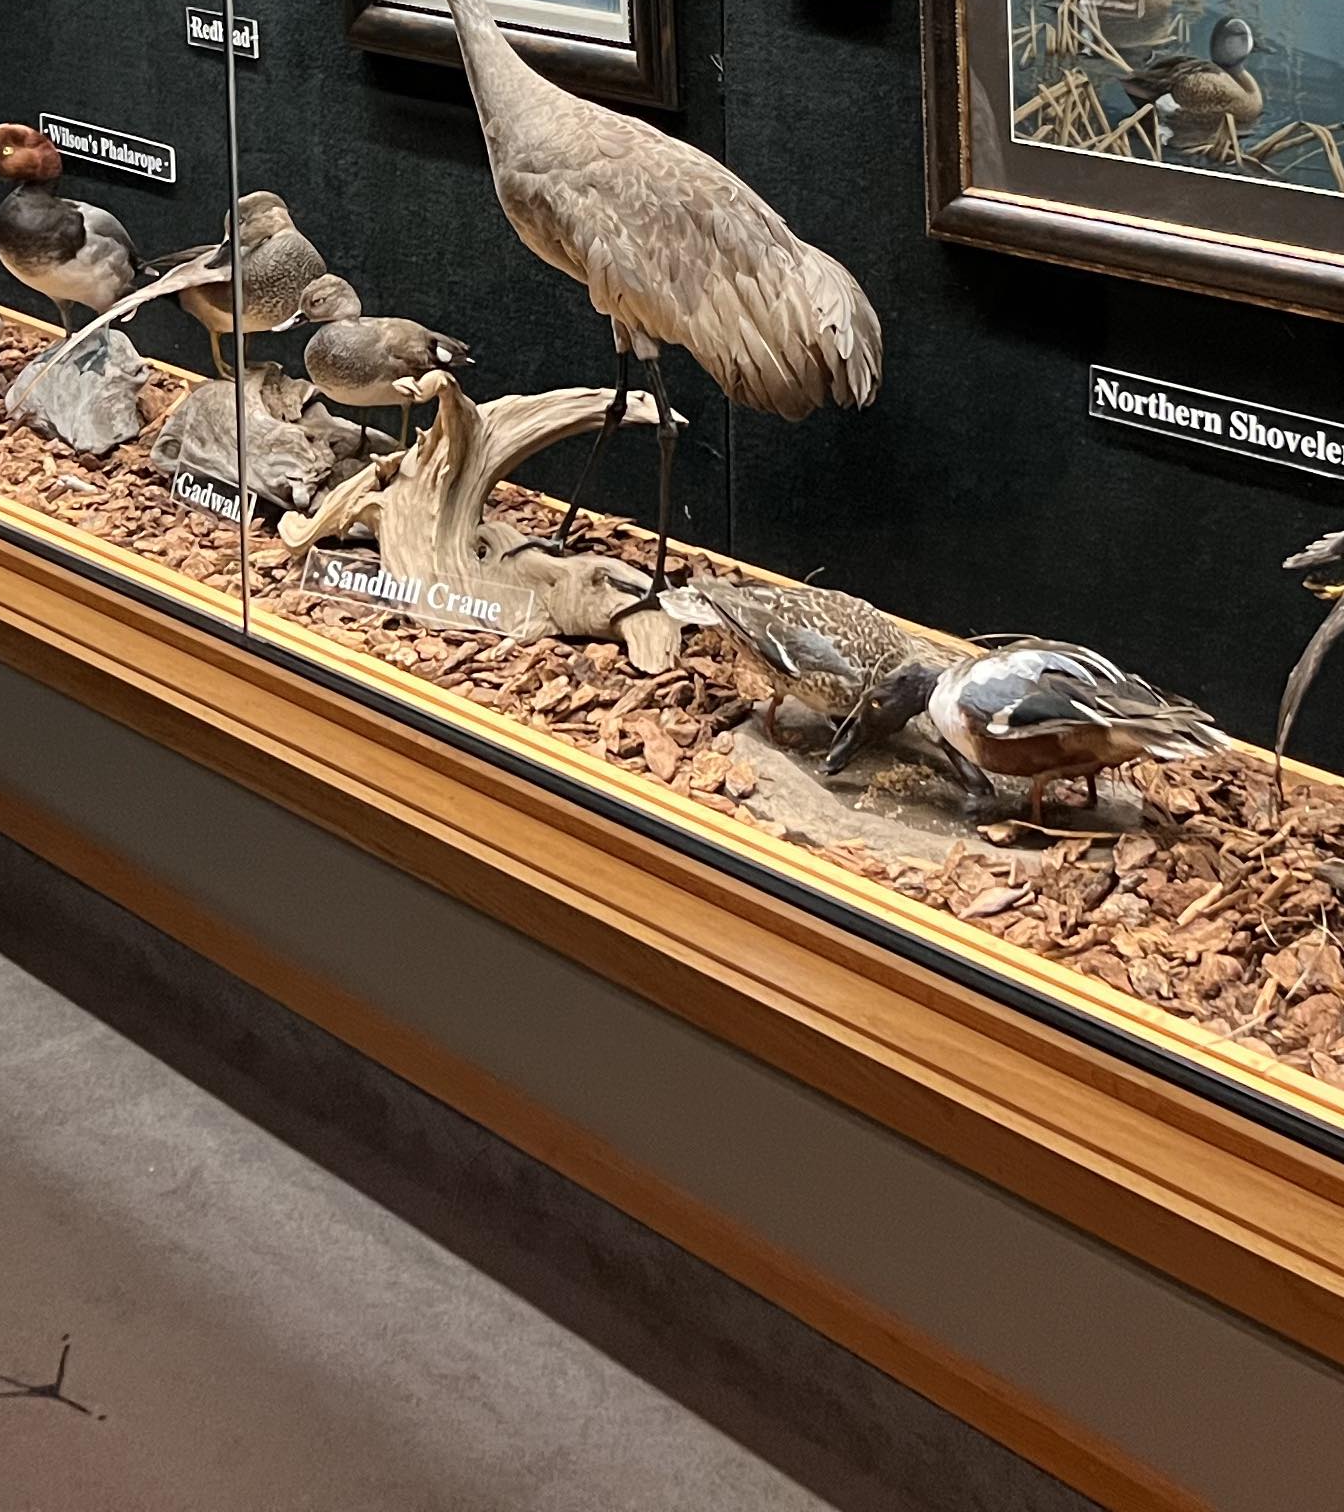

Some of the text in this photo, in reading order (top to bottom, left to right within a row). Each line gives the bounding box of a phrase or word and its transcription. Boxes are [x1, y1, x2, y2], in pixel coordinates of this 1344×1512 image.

[191, 16, 251, 48] Redhad
[48, 124, 163, 175] Wilson's Phalarope
[1096, 377, 1222, 435] Northern
[323, 560, 502, 622] Sandhill Crane
